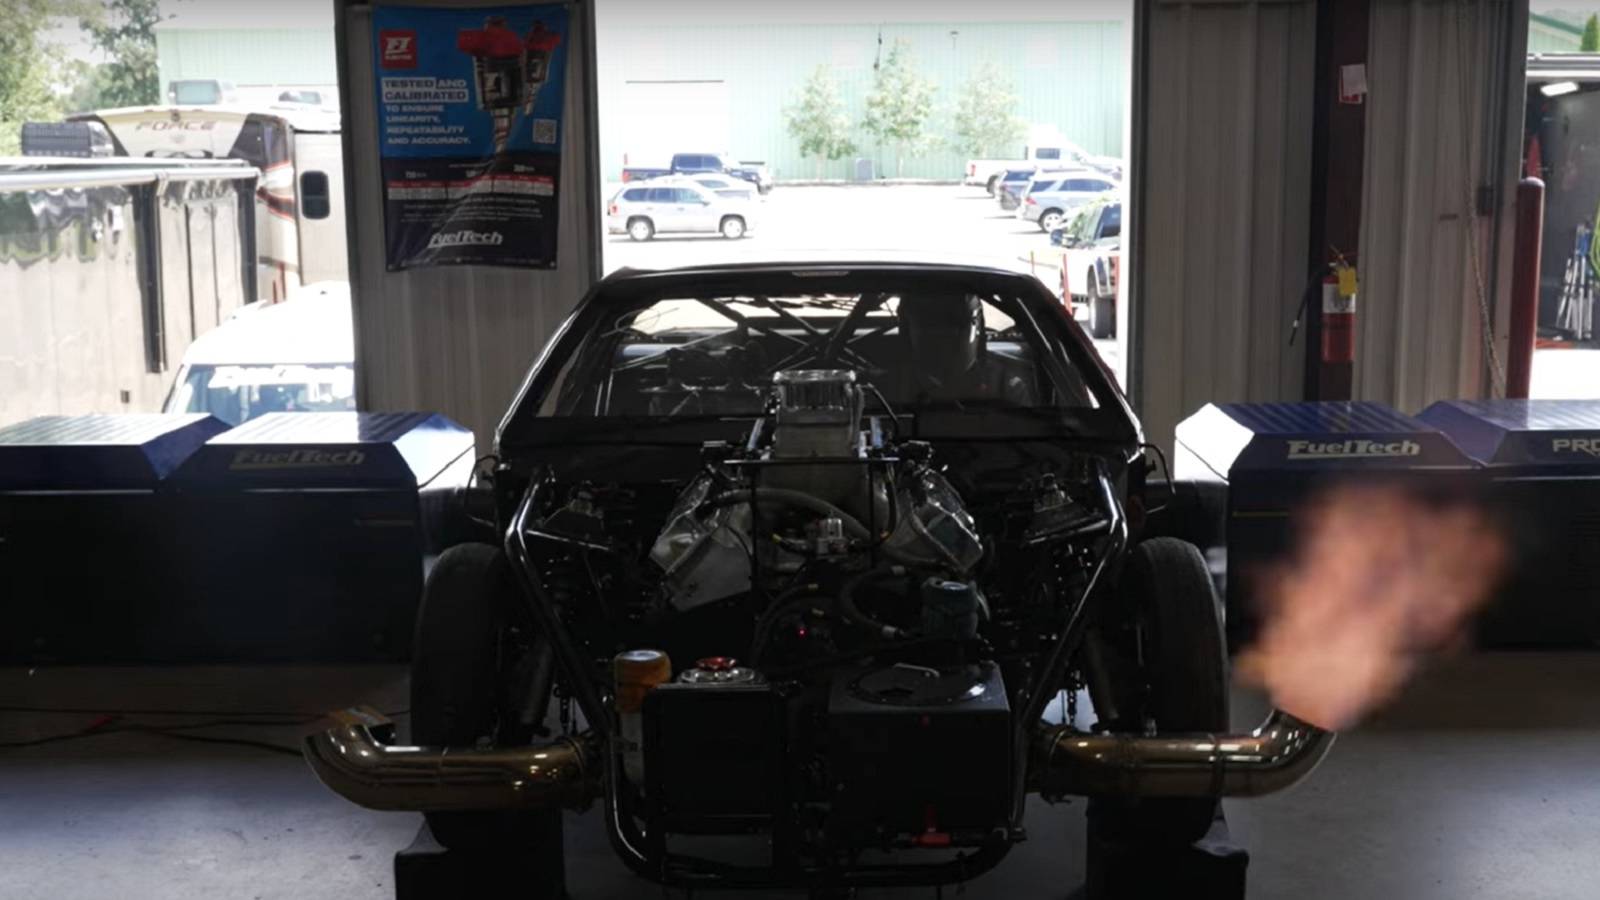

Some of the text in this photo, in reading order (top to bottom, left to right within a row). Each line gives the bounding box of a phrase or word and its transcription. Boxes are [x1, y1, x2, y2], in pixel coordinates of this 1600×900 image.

[384, 79, 467, 88] TESTED AND
[385, 91, 466, 101] CALIBRATED
[385, 104, 445, 113] TO ENSURE
[135, 121, 217, 131] FORCE
[386, 125, 465, 134] REPEATABILITY
[388, 137, 409, 145] AND
[427, 230, 503, 248] FuelTech
[1286, 439, 1421, 460] FuelTech
[229, 448, 366, 470] FuelTech
